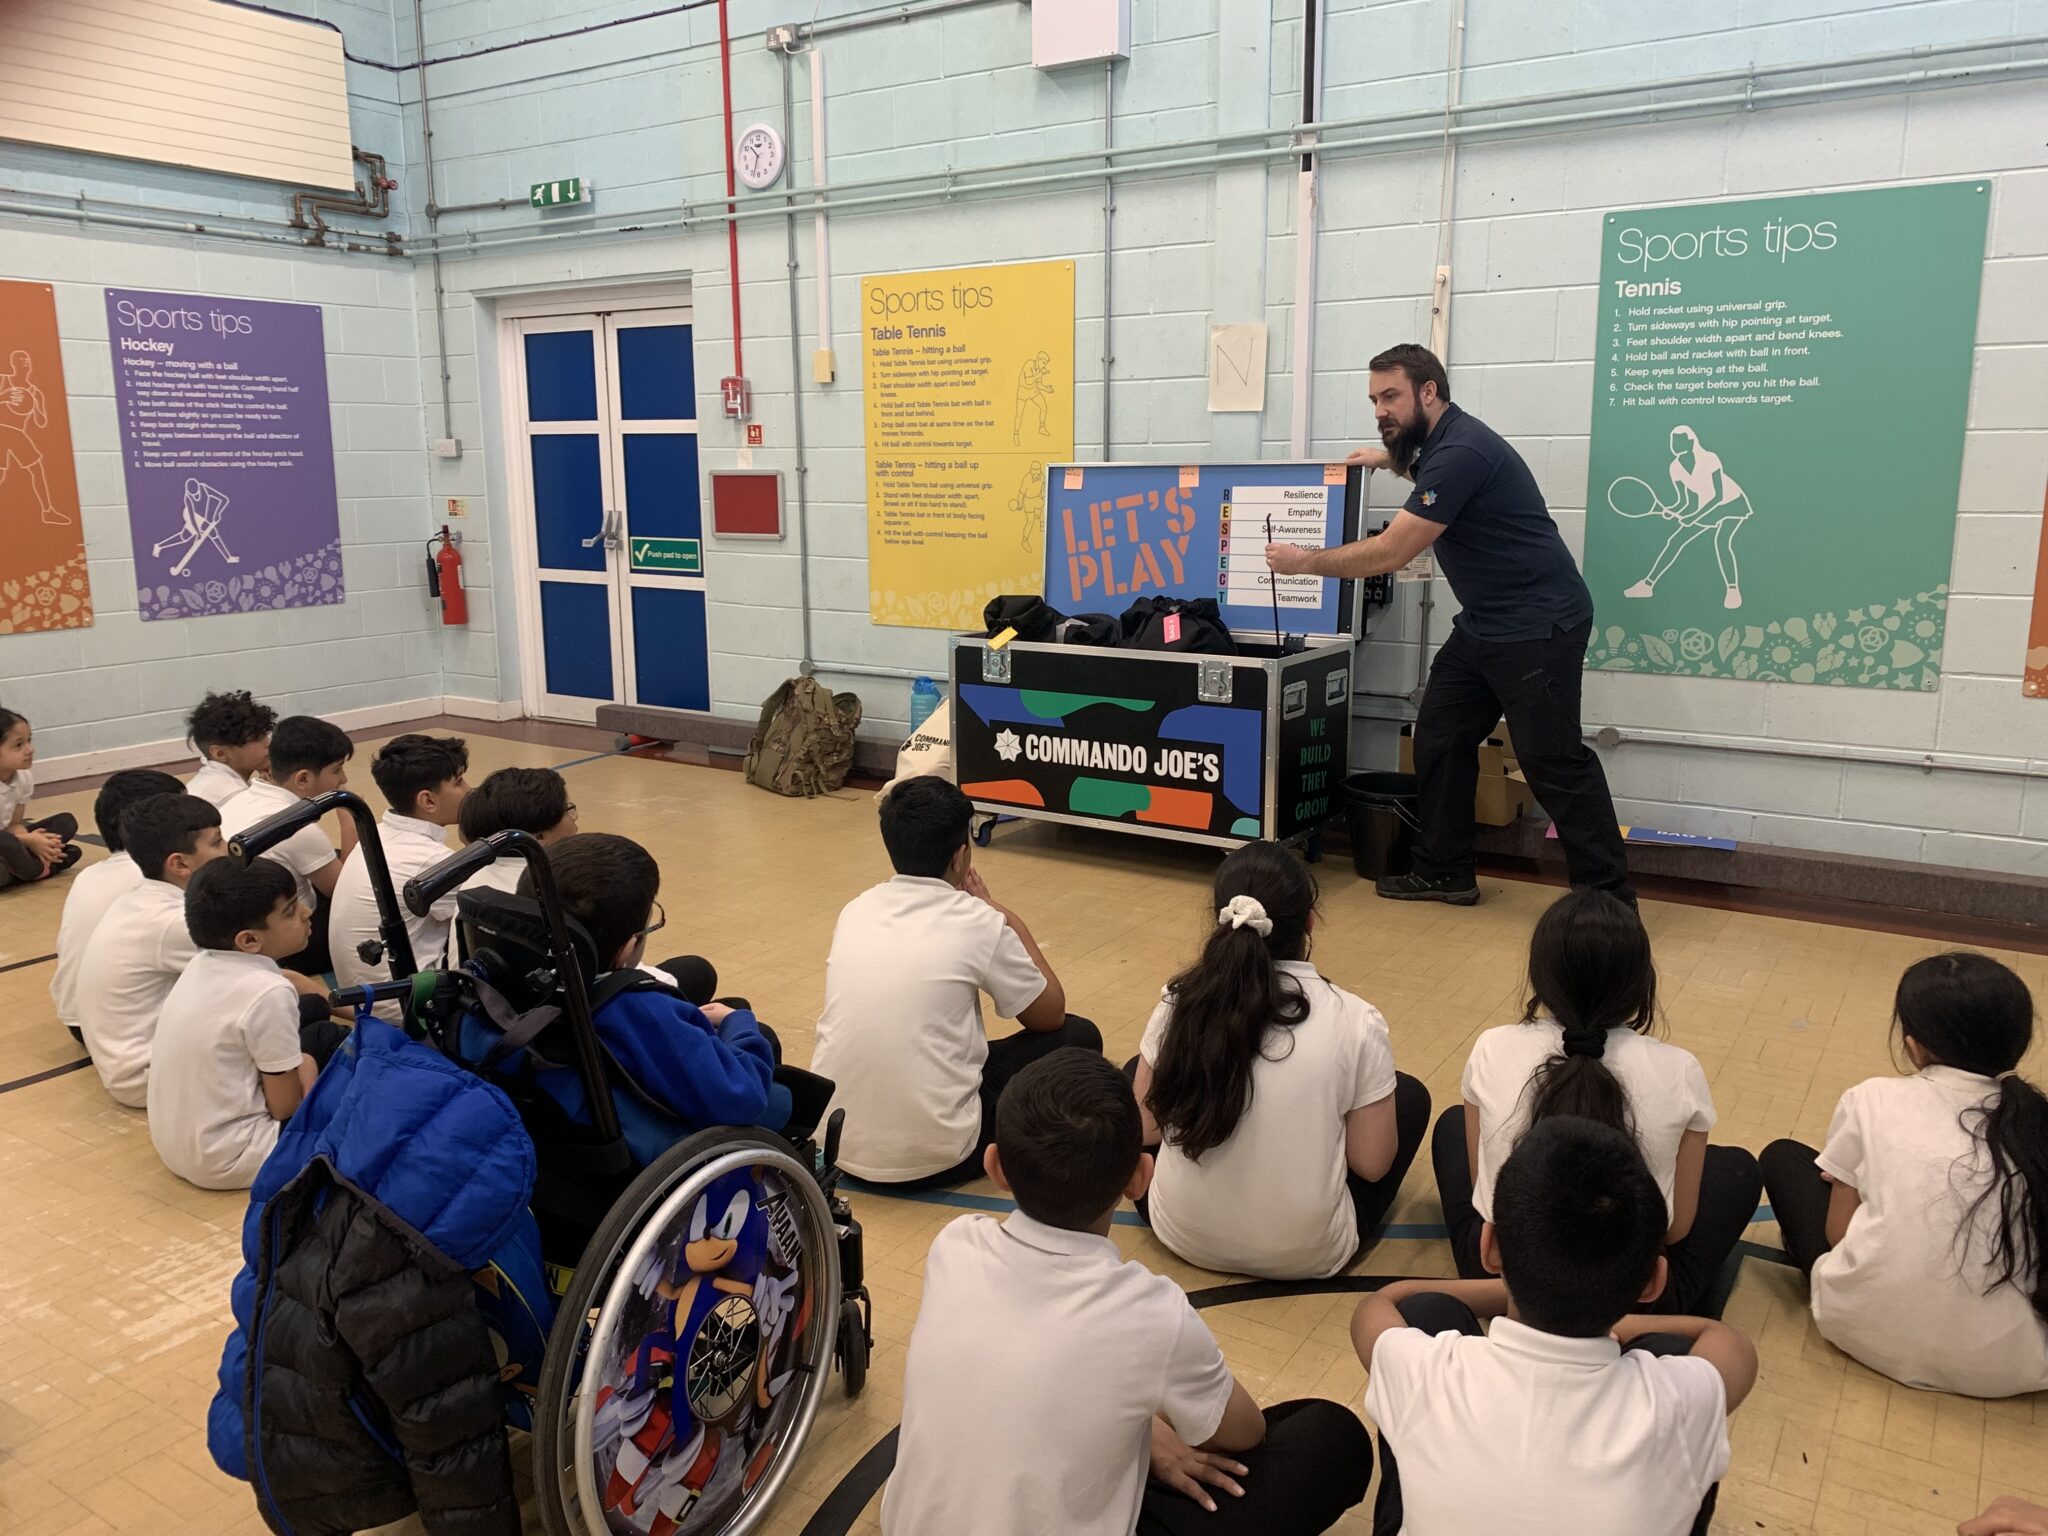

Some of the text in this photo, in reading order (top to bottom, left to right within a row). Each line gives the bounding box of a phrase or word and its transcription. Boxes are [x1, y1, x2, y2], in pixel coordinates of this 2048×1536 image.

[1618, 217, 1837, 272] Sports tips
[1615, 278, 1682, 298] Tennis
[870, 282, 994, 322] Sports tips
[1615, 300, 1787, 317] 1. Hold racket using universal grip.
[117, 300, 252, 339] Sports tips
[1613, 314, 1833, 332] 2. Turn sideways with hip pointing at target.
[871, 324, 946, 341] Table Tennis
[1612, 330, 1844, 347] 3. Feet shoulder width apart and bend knees.
[120, 337, 174, 356] Hockey
[872, 349, 890, 357] Table
[892, 347, 914, 355] Tennis
[922, 346, 944, 356] hitting
[953, 344, 966, 353] ball
[1612, 346, 1810, 362] 4. Hold ball and racket with ball in front.
[123, 358, 155, 369] Hockey
[165, 360, 196, 370] moving
[197, 361, 215, 369] with
[223, 362, 238, 370] ball
[1217, 336, 1254, 387] N
[1611, 363, 1769, 378] 5. Keep eyes looking at the ball.
[1610, 377, 1820, 392] 6. Check the target before you hit the ball.
[1609, 394, 1794, 407] 7. Hit ball with control towards target.
[875, 461, 893, 469] Table
[925, 461, 946, 470] hitting
[955, 461, 968, 469] ball
[970, 463, 979, 471] up
[1284, 491, 1324, 499] Resilience
[1288, 508, 1323, 518] Empathy
[663, 552, 674, 560] pad
[1068, 535, 1190, 602] PLAY
[1277, 594, 1318, 603] Teamwork
[1310, 718, 1326, 737] WE
[1025, 734, 1220, 783] COMMANDO JOE'S
[1300, 744, 1332, 766] BUILD
[1302, 770, 1327, 793] THEY
[1295, 796, 1329, 821] GROW
[756, 1190, 802, 1268] AYAAN
